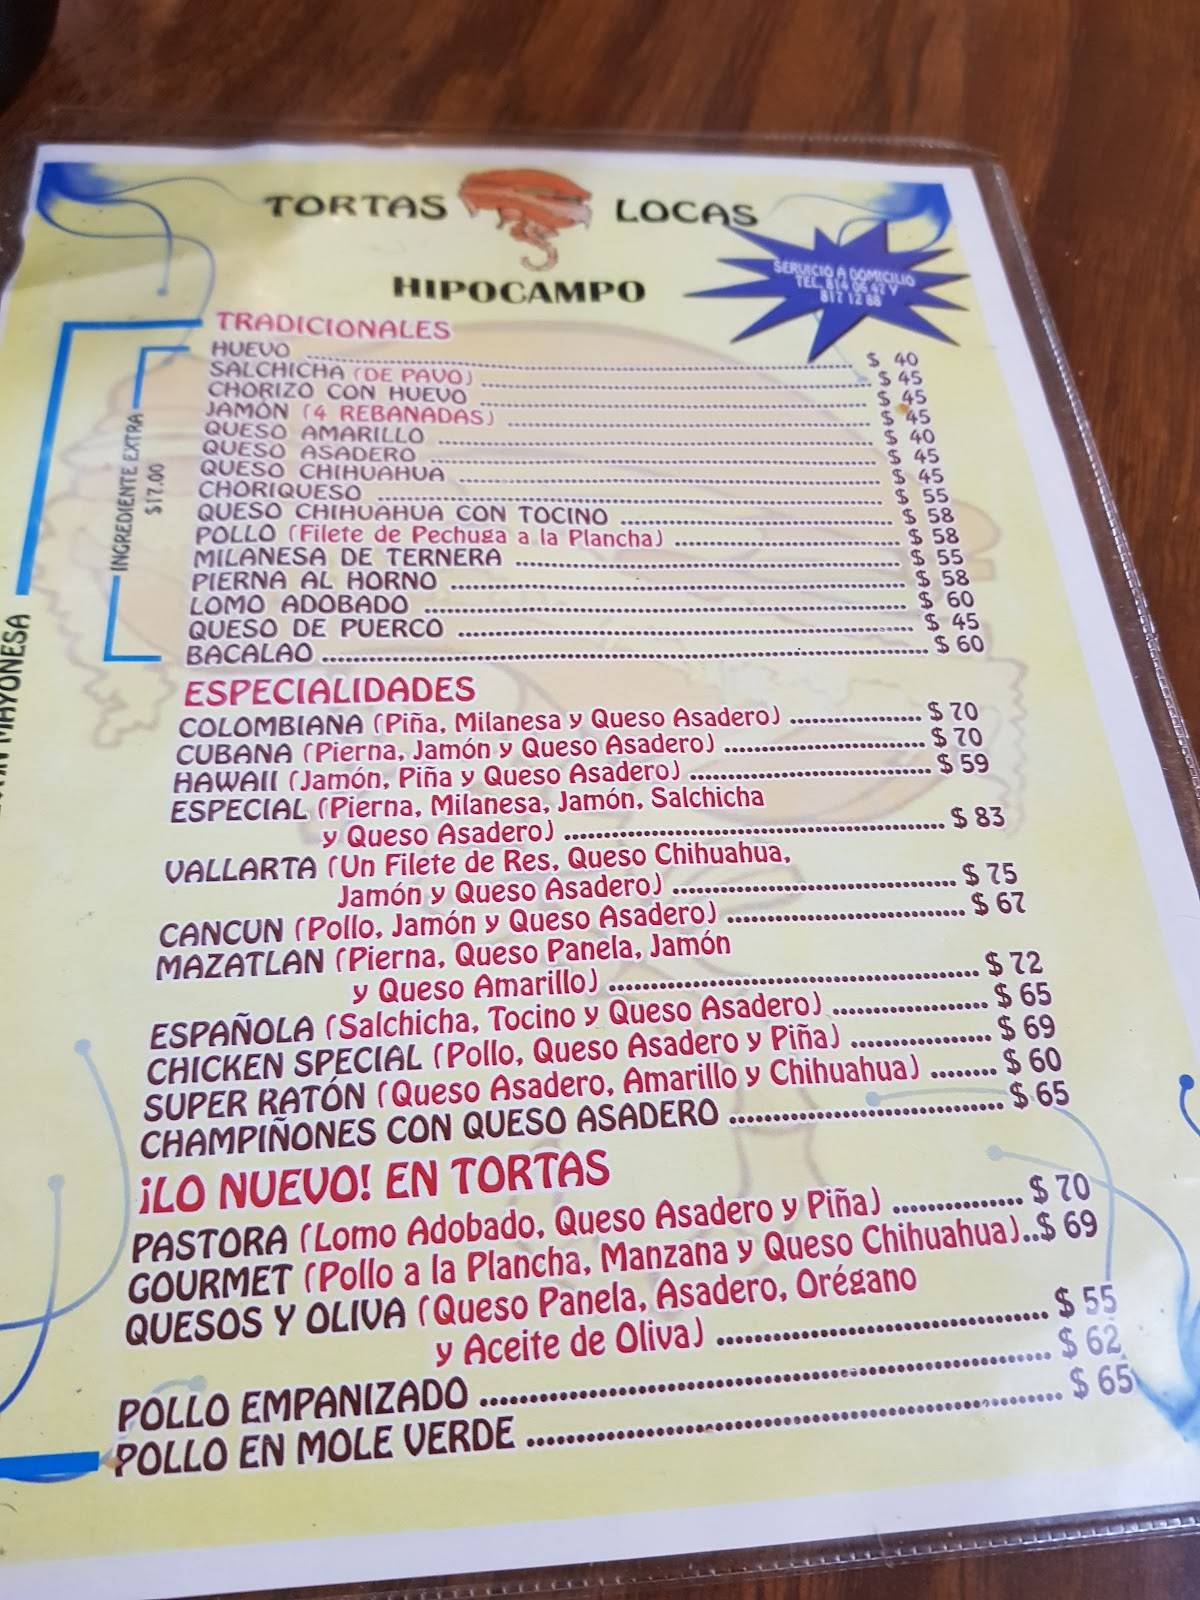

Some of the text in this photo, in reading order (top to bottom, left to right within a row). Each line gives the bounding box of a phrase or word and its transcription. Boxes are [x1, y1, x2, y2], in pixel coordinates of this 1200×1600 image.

[264, 194, 758, 226] TORTAS LOCAS
[774, 260, 833, 278] SERVICIO
[850, 268, 916, 287] DOMICILIO
[394, 276, 645, 304] HIPOCAMPO
[217, 312, 450, 339] TRADICIONALES
[212, 341, 918, 366] HUEVO 40
[210, 361, 922, 386] SALCHICHA PAVO) 45
[208, 382, 467, 405] CHORIZO CON HUEVO
[206, 401, 494, 426] JAMÓN REBANADAS)
[204, 421, 935, 444] QUESO AMARILLO 40
[203, 440, 940, 464] QUESO ASADERO 45
[201, 459, 944, 484] QUESO CHIHUAHUA 45
[110, 412, 144, 572] INGREDIENTE EXTRA
[199, 481, 949, 504] CHORIQUESO 55
[198, 502, 954, 526] QUESO CHIHUAHUA CON TOCINO 58
[196, 525, 663, 549] POLLO (Filete Pechuga Plancha)
[194, 547, 502, 568] MILANESA DE TERNERA
[192, 569, 970, 592] PIERNA AL HORNO 58
[190, 594, 409, 617] LOMO ADOBADO
[188, 613, 979, 642] QUESO DE PUERCO 45
[186, 635, 984, 665] BACALAO 60
[185, 675, 475, 706] ESPECIALIDADES
[179, 701, 978, 739] COLOMBIANA (Piña, Milanesa 70
[176, 738, 491, 766] CUBANA (Pierna, Jamón
[173, 761, 680, 793] HAWAII (Jamón, Piña Asadero)
[171, 786, 764, 823] ESPECIAL (Pierna, Milanesa, Jamón, Salchicha
[437, 806, 1005, 845] Asadero) 83
[165, 841, 790, 883] VALLARTA (Un Filete Res, Chihuahua,
[338, 862, 1017, 908] Jamón 75
[159, 901, 717, 947] CANCUN (Pollo, Jamón Asadero)
[156, 930, 731, 981] MAZATLAN (Pierna, Panela, Jamón
[474, 950, 1043, 999] Amarillo) 72
[150, 991, 822, 1050] ESPAÑOLA (Salchicha, Tocino Asadero)
[147, 1014, 1056, 1085] CHICKEN SPECIAL (Pollo, Asadero Piña) 69
[143, 1054, 919, 1122] SUPER RATÓN (Queso Asadero, Amarillo Chihuahua)
[140, 1097, 719, 1159] CHAMPIÑONES CON QUESO ASADERO
[139, 1149, 610, 1215] ¡LO NUEVO! EN TORTAS
[132, 1172, 1090, 1264] PASTORA (Lomo Adobado, Asadero Piña) 70
[128, 1263, 293, 1305] GOURMET
[305, 1257, 393, 1293] (Pollo
[467, 1245, 590, 1282] Plancha,
[601, 1240, 728, 1273] Manzana
[125, 1263, 916, 1346] QUESOS Y OLIVA (Queso Panela, Asadero, Orégano
[463, 1284, 1118, 1365] Aceite Oliva) 55
[118, 1324, 1121, 1432] POLLO EMPANIZADO 62
[115, 1364, 1133, 1477] POLLO EN MOLE VERDE 65
